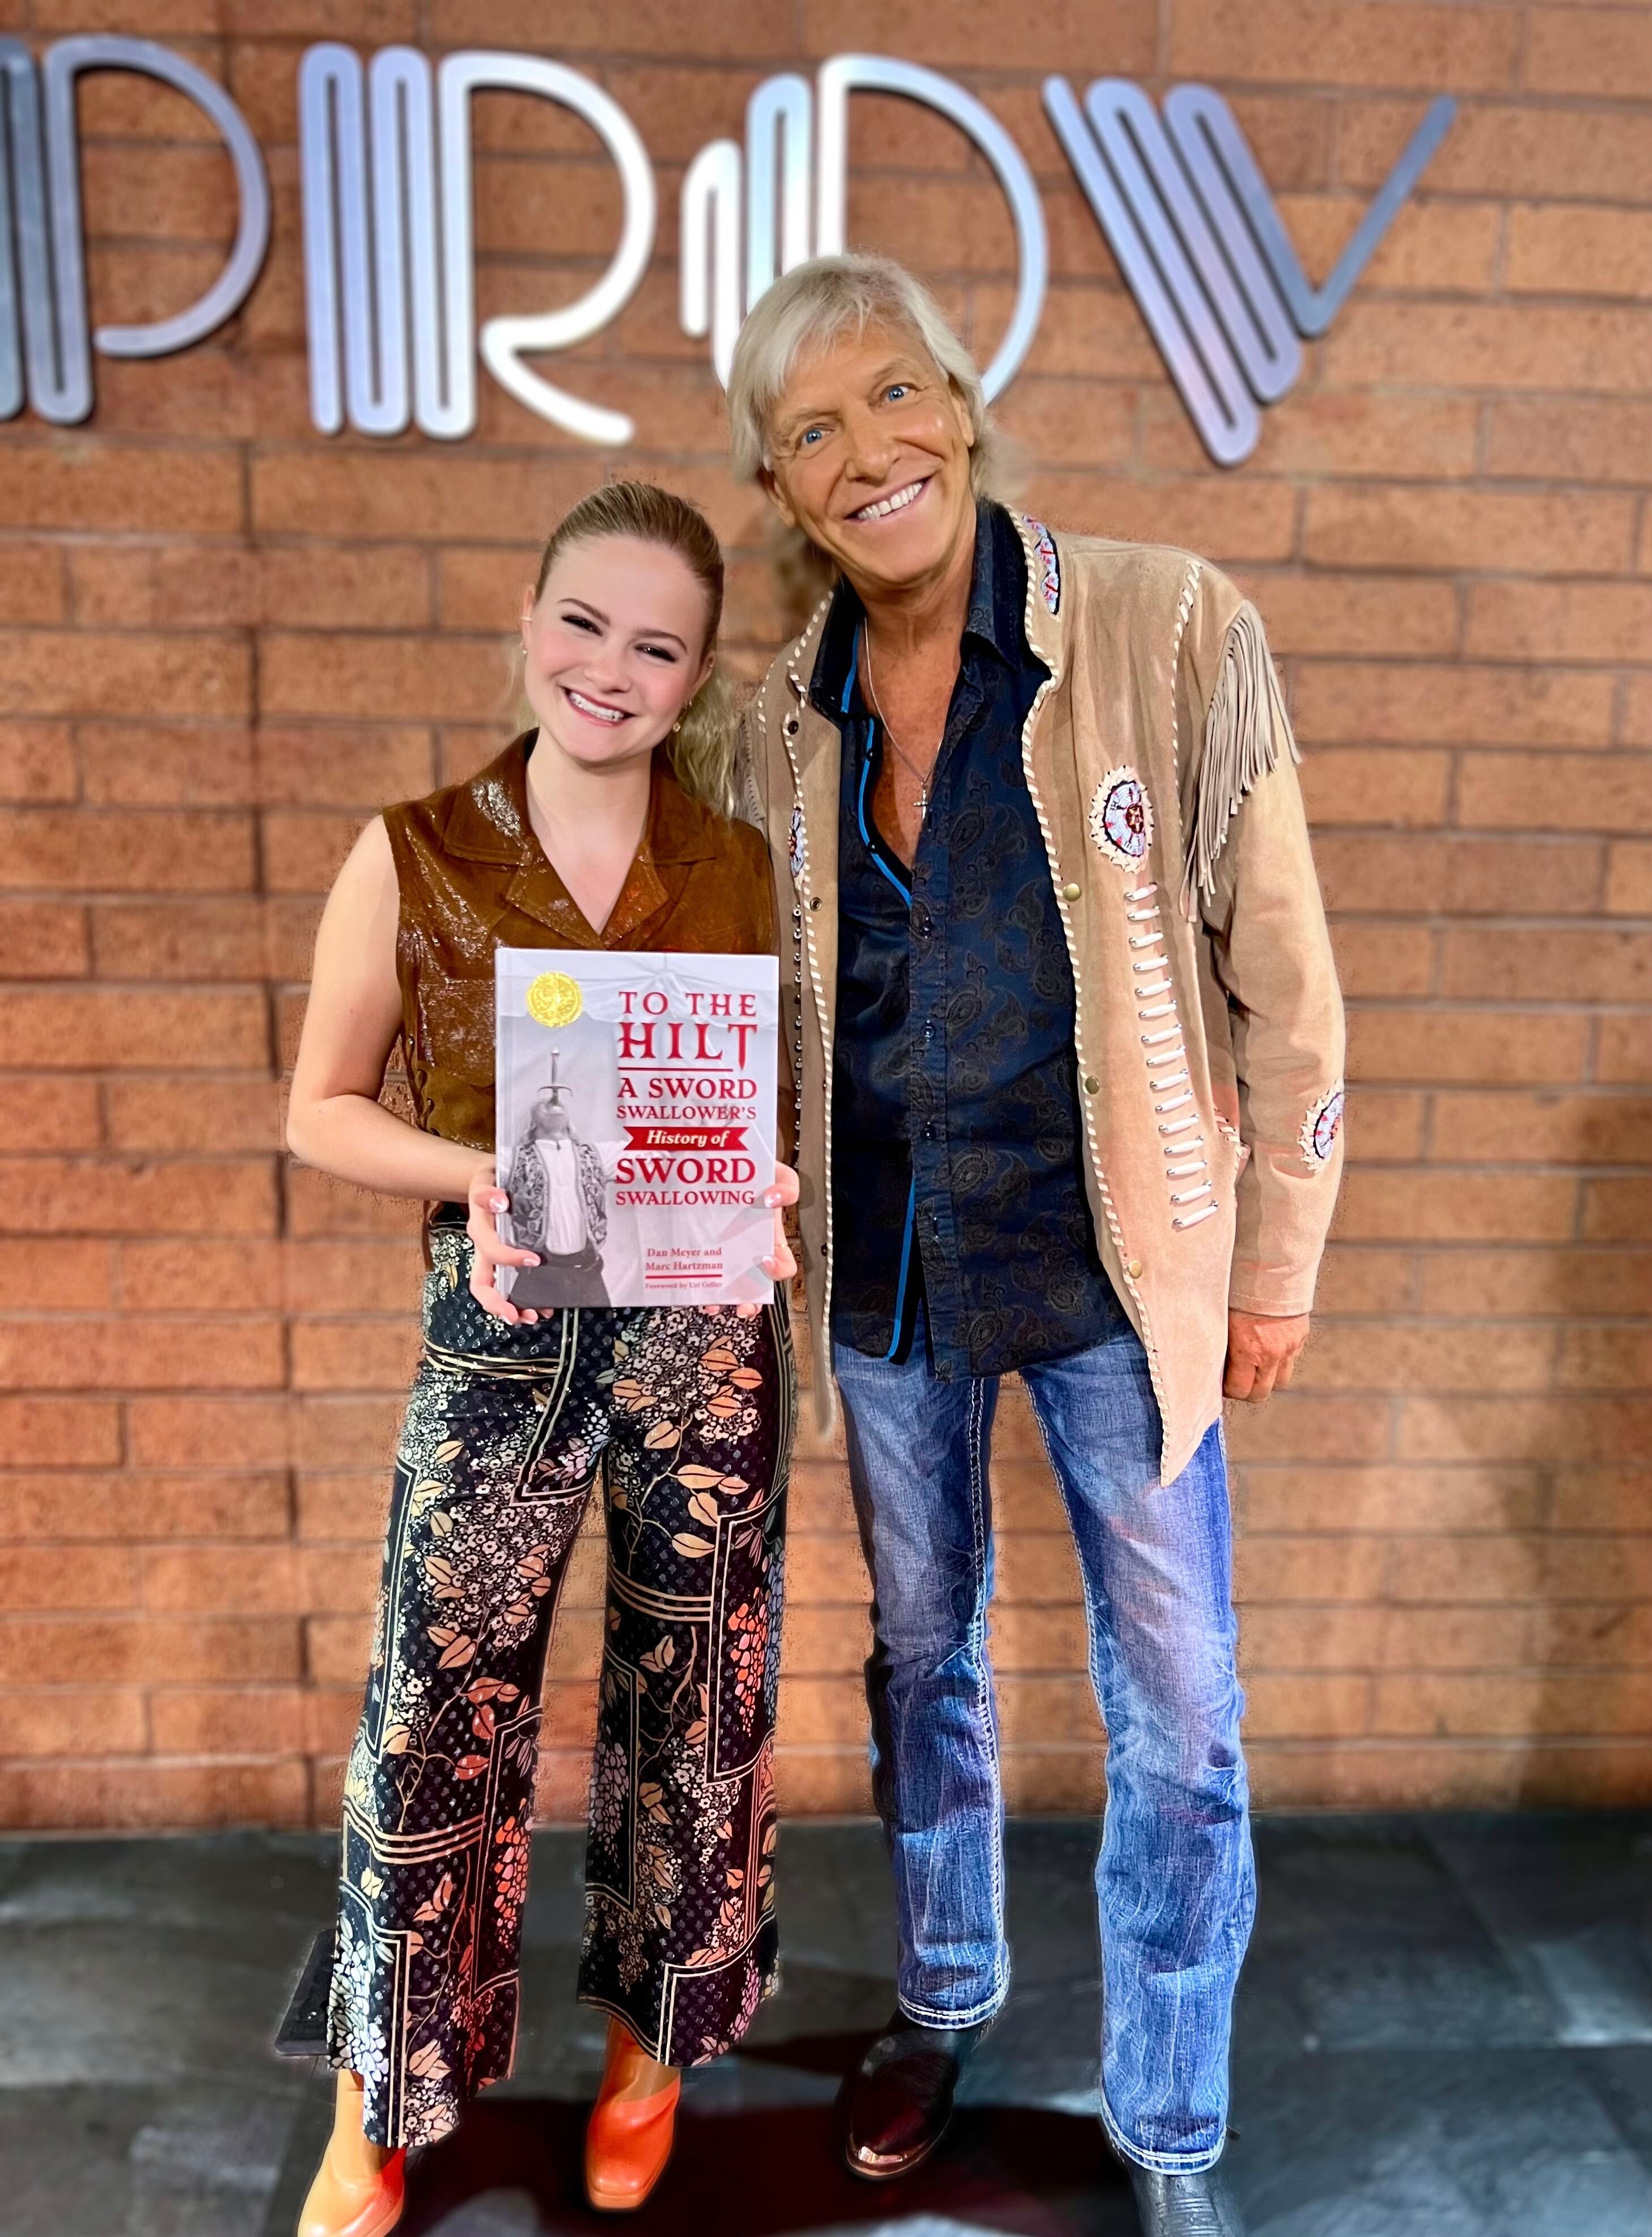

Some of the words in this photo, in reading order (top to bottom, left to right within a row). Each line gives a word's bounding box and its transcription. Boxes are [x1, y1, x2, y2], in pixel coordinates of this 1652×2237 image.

[619, 992, 668, 1015] TO
[685, 993, 757, 1017] THE
[618, 1022, 758, 1072] HILT
[617, 1078, 638, 1098] A
[649, 1078, 757, 1099] SWORD
[616, 1105, 756, 1120] SWALLOWER'S
[646, 1130, 708, 1147] History
[711, 1130, 730, 1147] of
[616, 1158, 756, 1184] SWORD
[616, 1190, 755, 1205] SWALLOWING
[647, 1248, 668, 1257] Dan
[670, 1248, 701, 1259] Meyer
[704, 1247, 722, 1256] and
[646, 1262, 671, 1271] Marc
[673, 1261, 723, 1270] Hartzman
